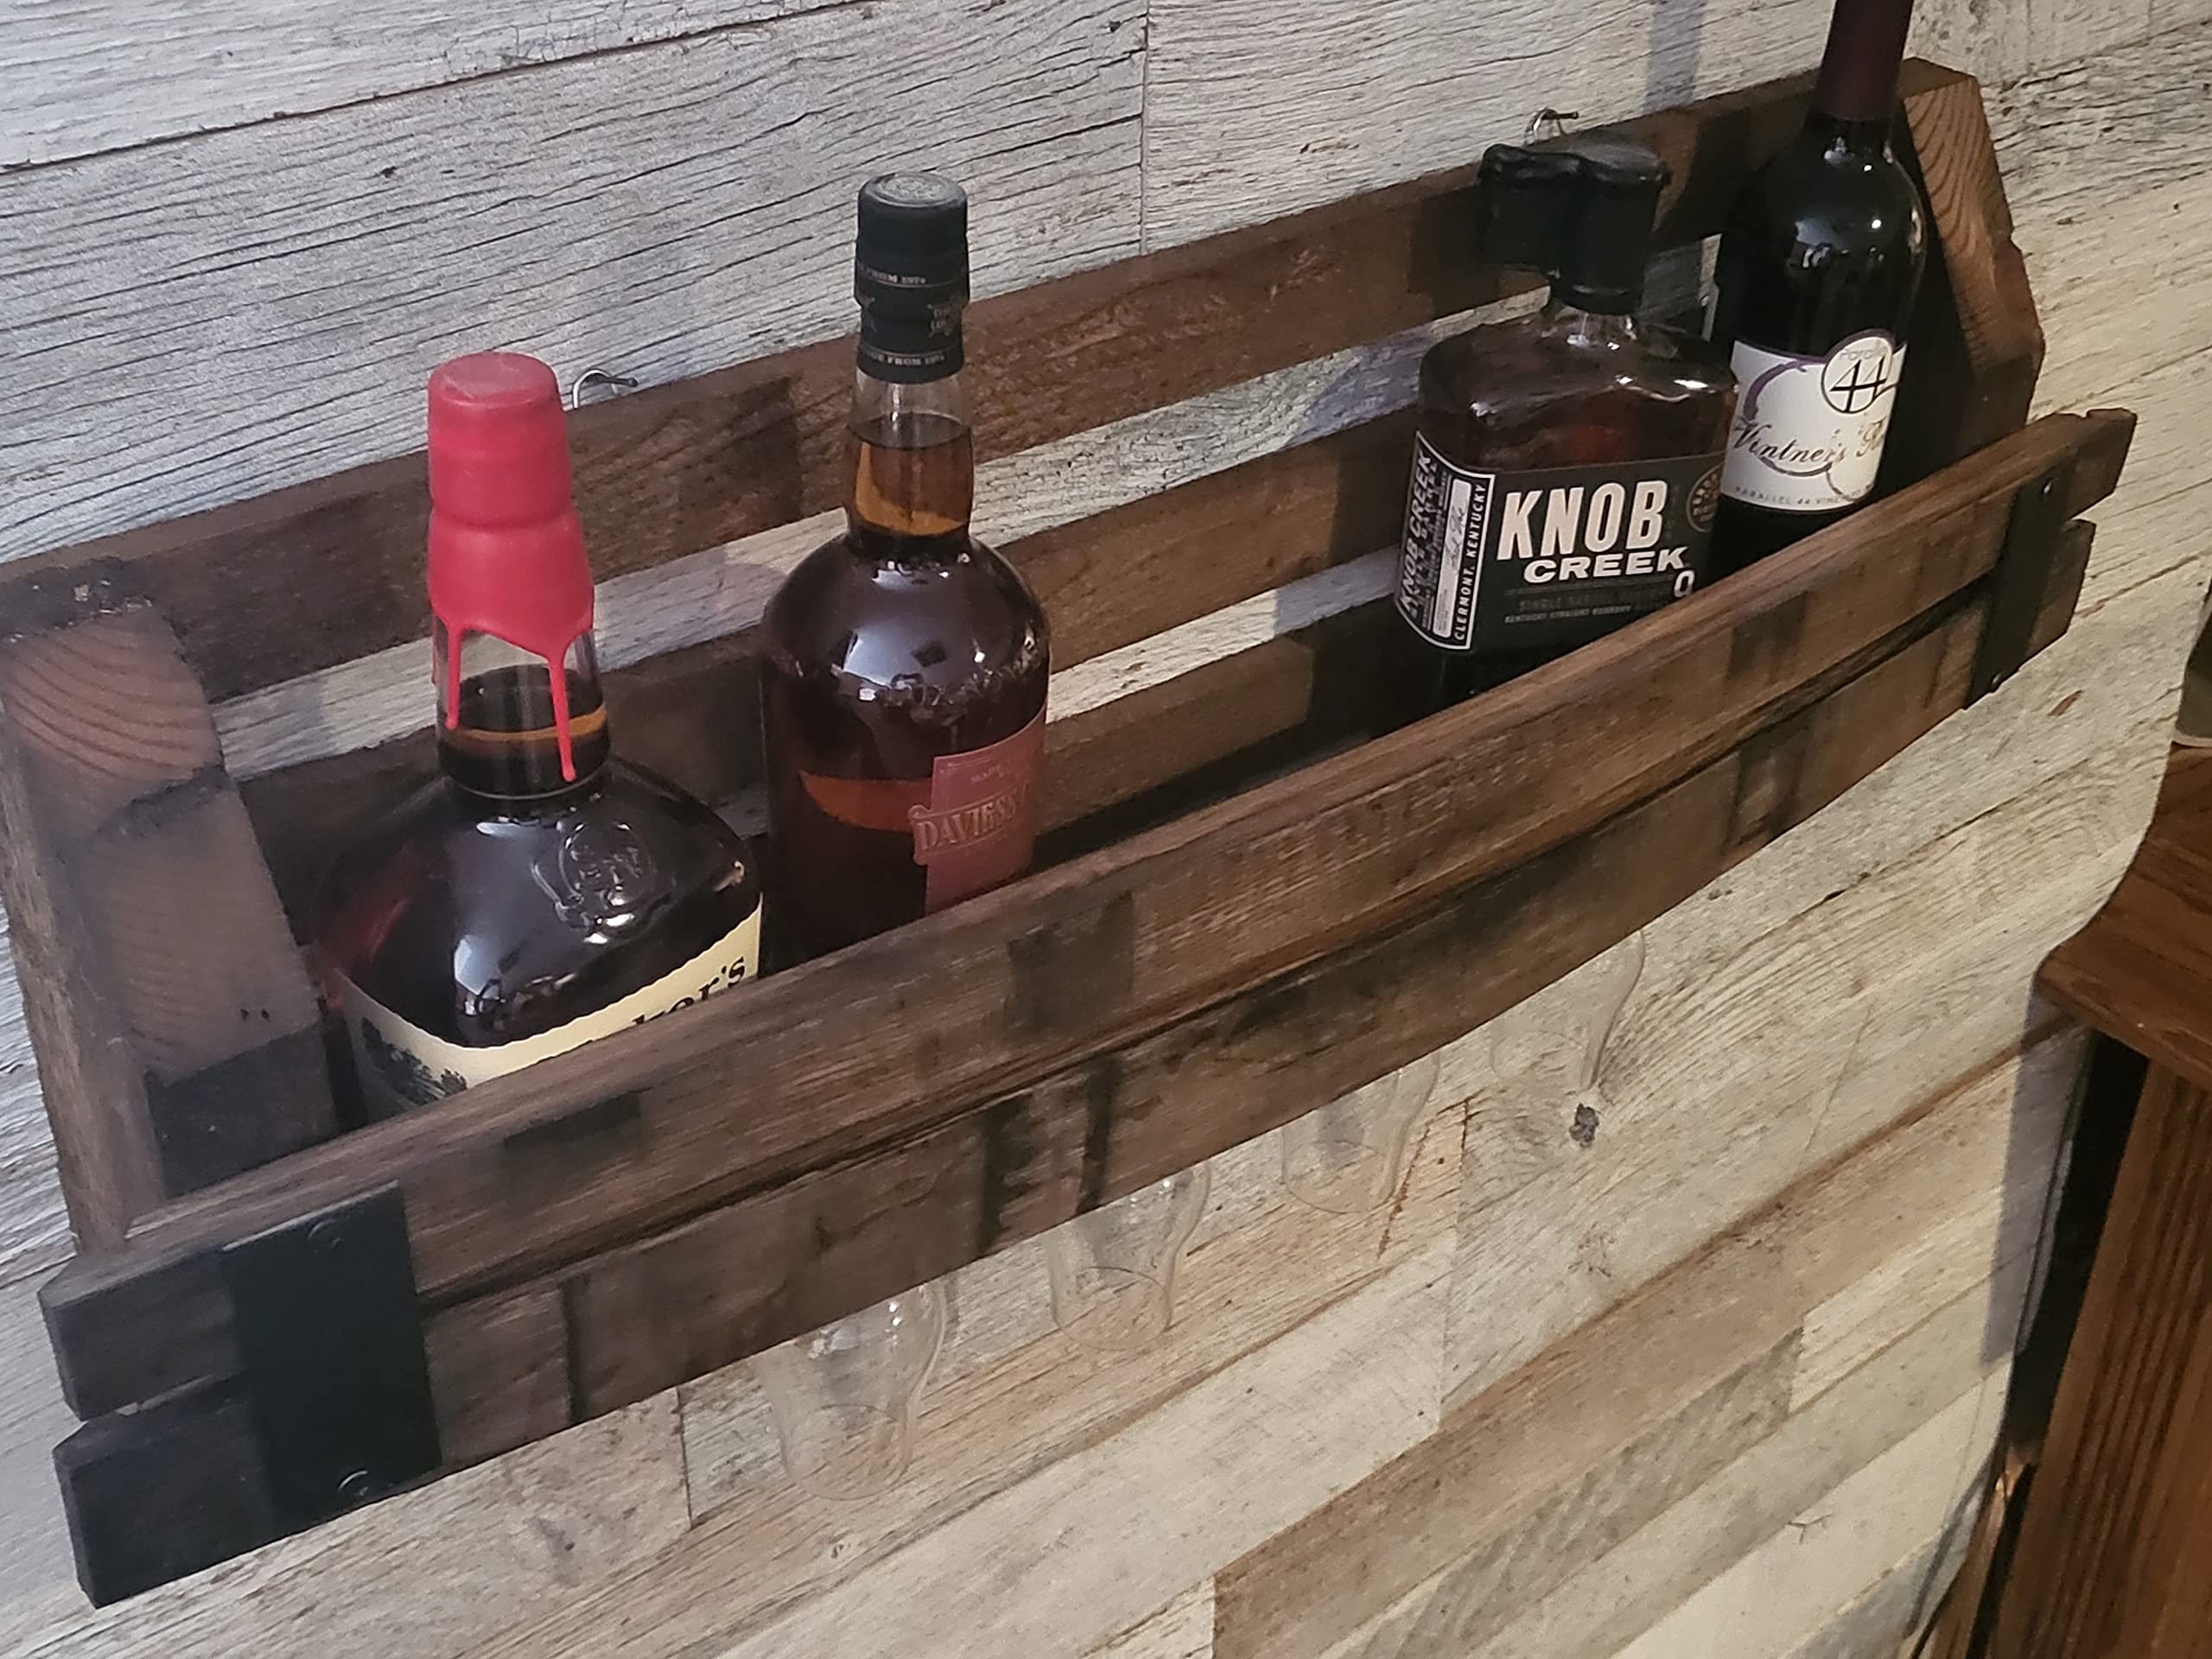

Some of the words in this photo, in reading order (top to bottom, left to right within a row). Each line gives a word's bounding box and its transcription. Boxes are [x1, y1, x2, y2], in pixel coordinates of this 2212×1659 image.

[1733, 416, 1847, 463] Vintner's
[1408, 448, 1432, 537] CREEK
[1465, 484, 1486, 557] KENTUCKY
[1497, 480, 1669, 561] KNOB
[1400, 537, 1420, 613] KNOB
[1523, 546, 1688, 583] CREEK
